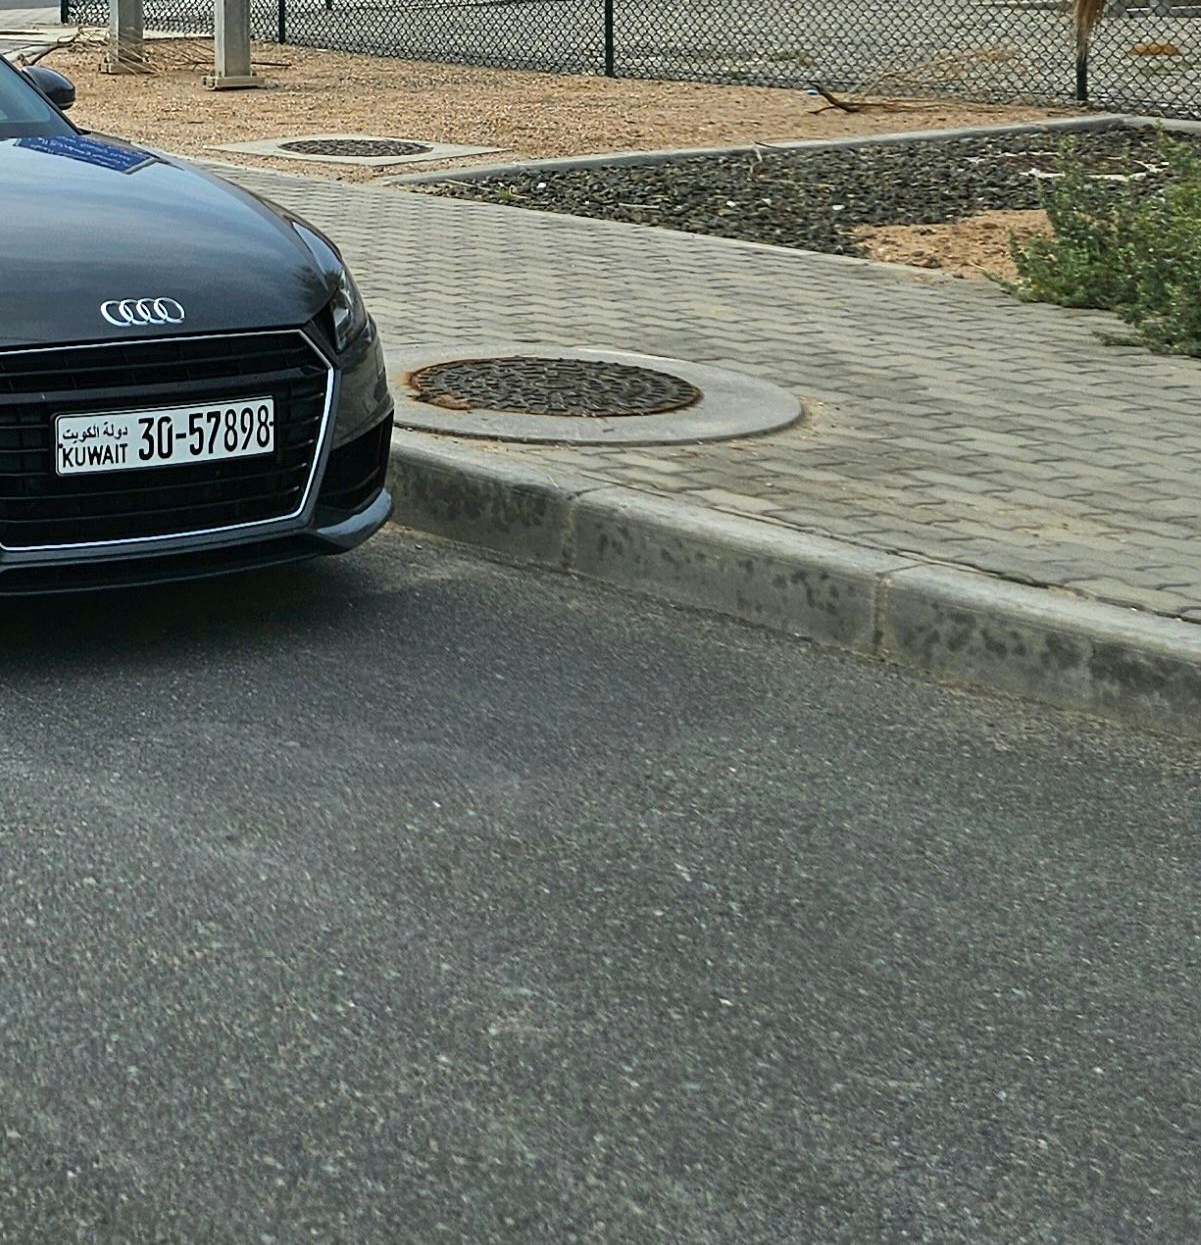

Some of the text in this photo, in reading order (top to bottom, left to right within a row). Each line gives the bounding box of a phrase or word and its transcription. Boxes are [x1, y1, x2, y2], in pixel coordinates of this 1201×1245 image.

[62, 422, 127, 444] دولة الكويت
[138, 404, 271, 461] 30-57898
[62, 443, 128, 468] KUWAIT
